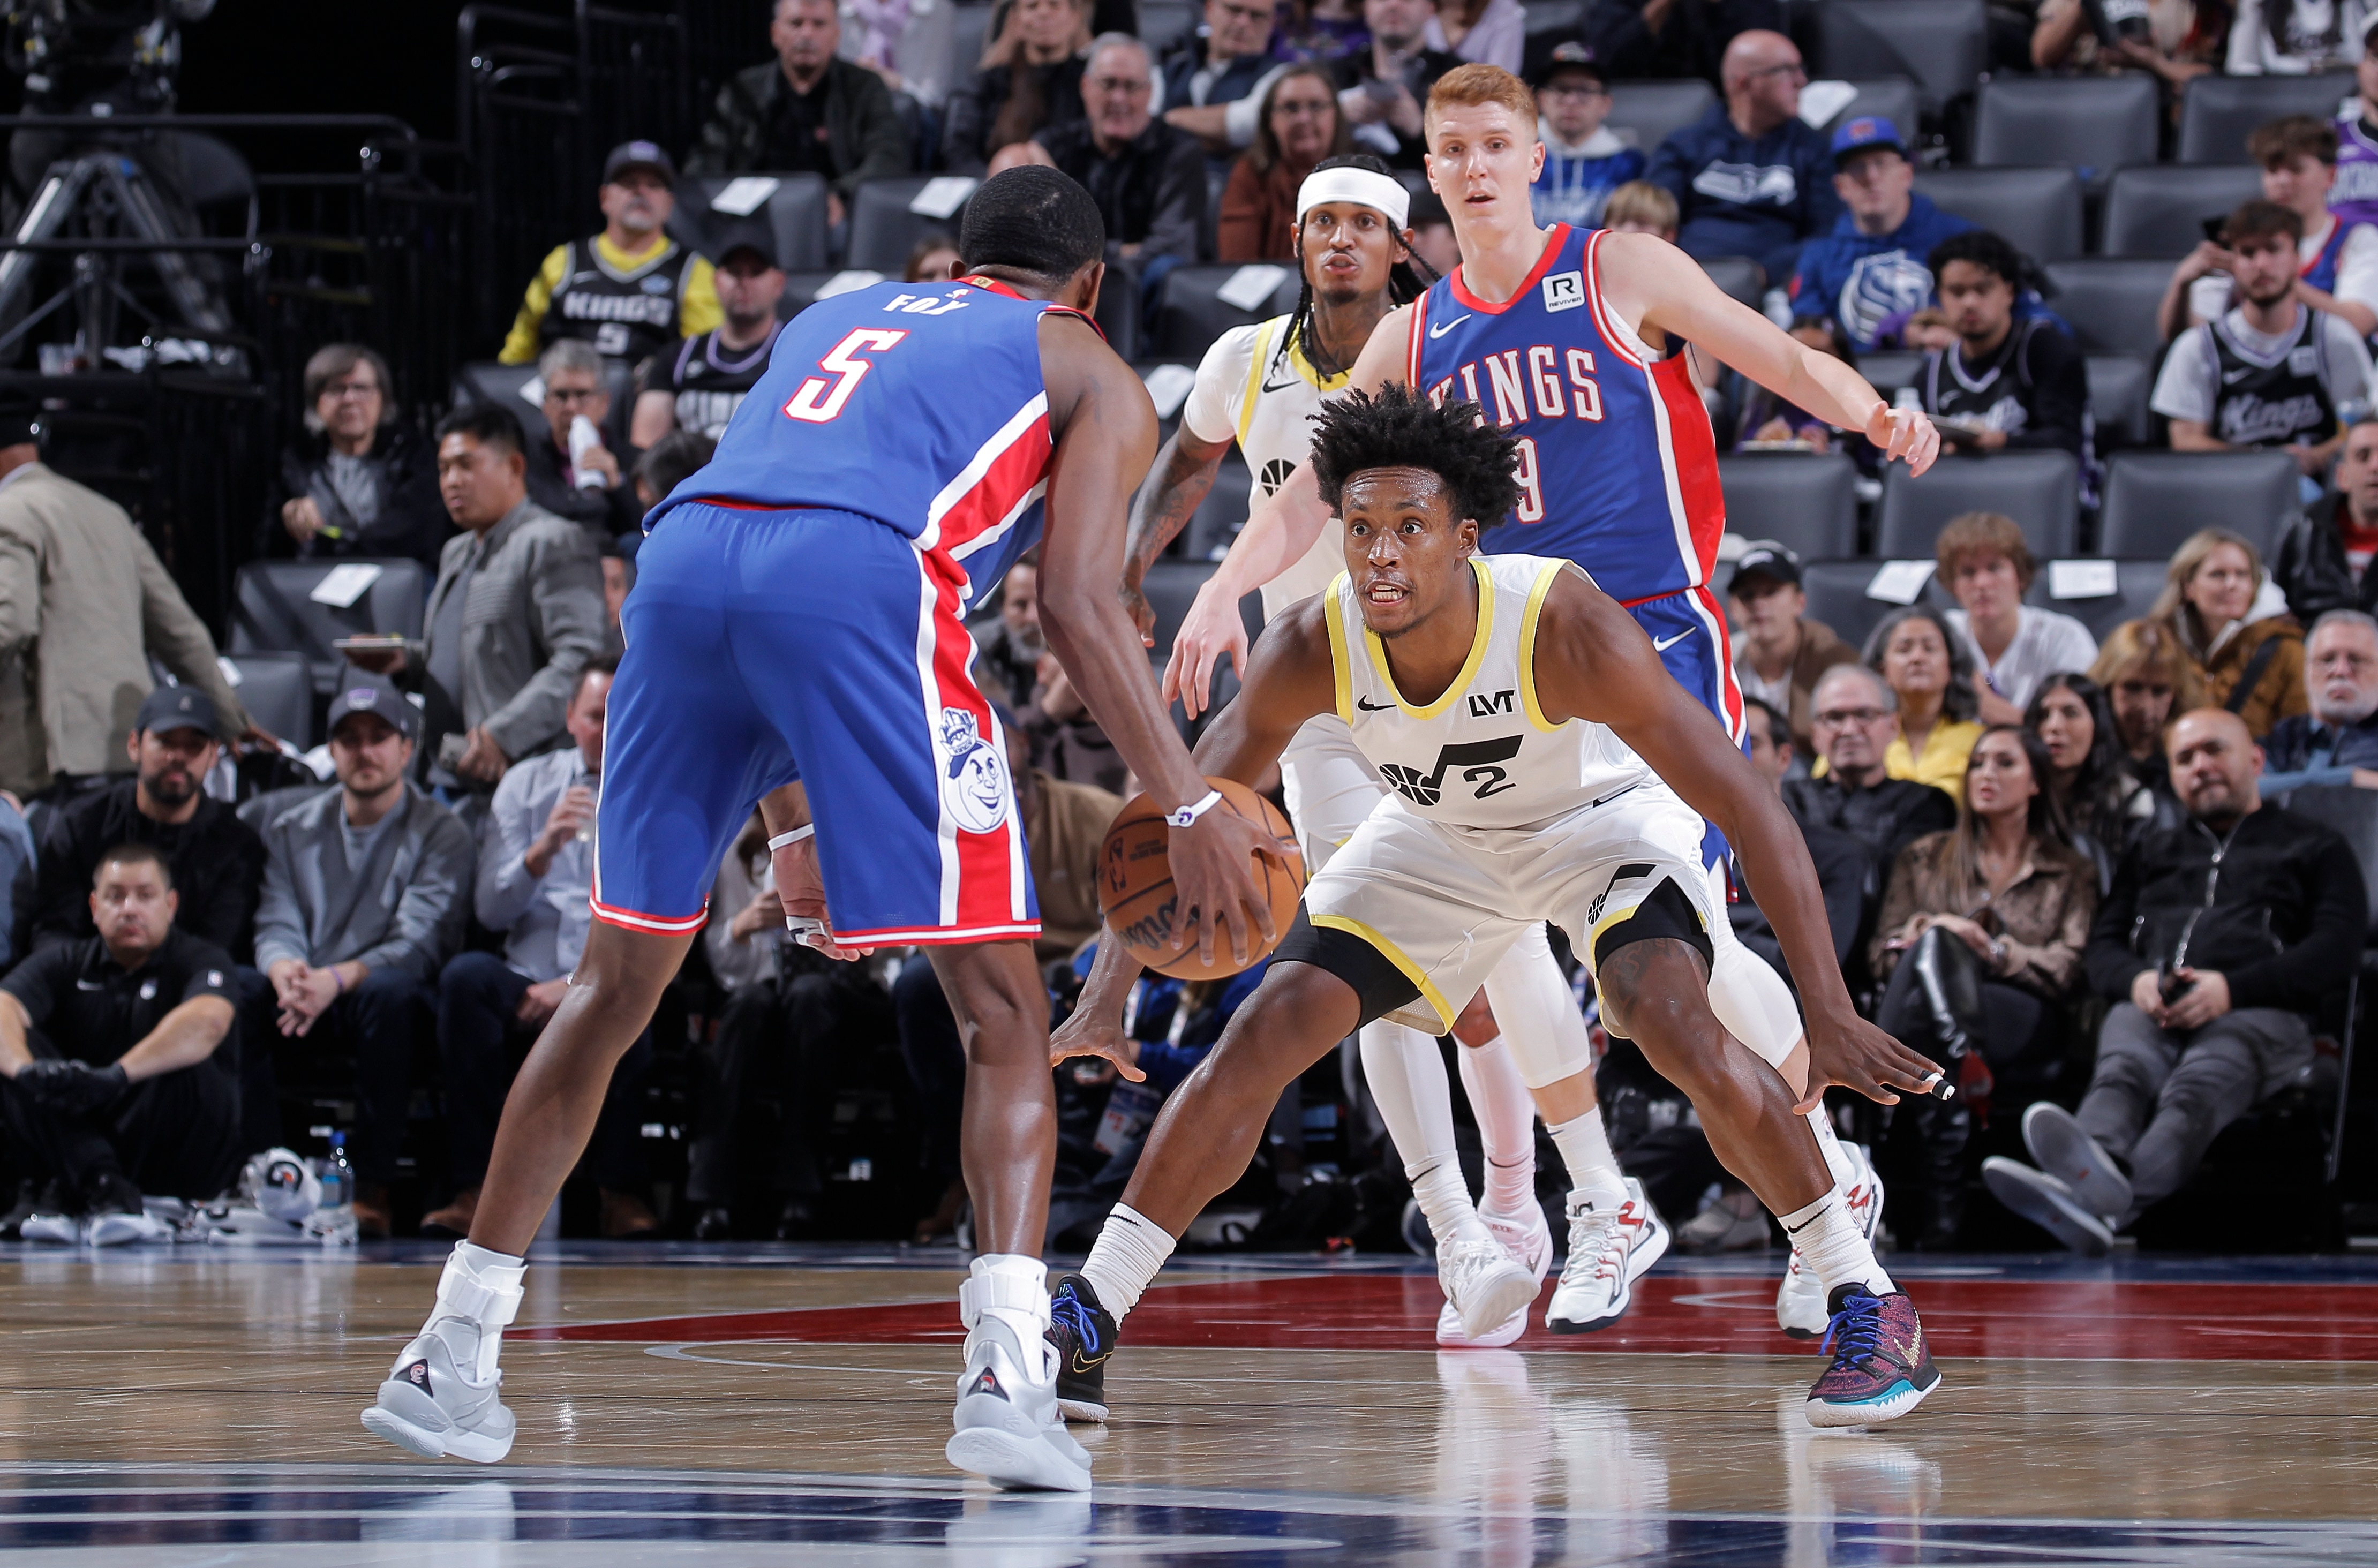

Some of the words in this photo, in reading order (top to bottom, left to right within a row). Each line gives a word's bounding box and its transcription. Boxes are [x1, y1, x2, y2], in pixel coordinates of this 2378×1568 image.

[1552, 277, 1576, 297] R
[882, 293, 970, 315] FOX
[1549, 296, 1582, 308] REVIVER
[781, 327, 910, 424] 5
[1468, 690, 1515, 717] LVT
[1463, 766, 1517, 800] 2
